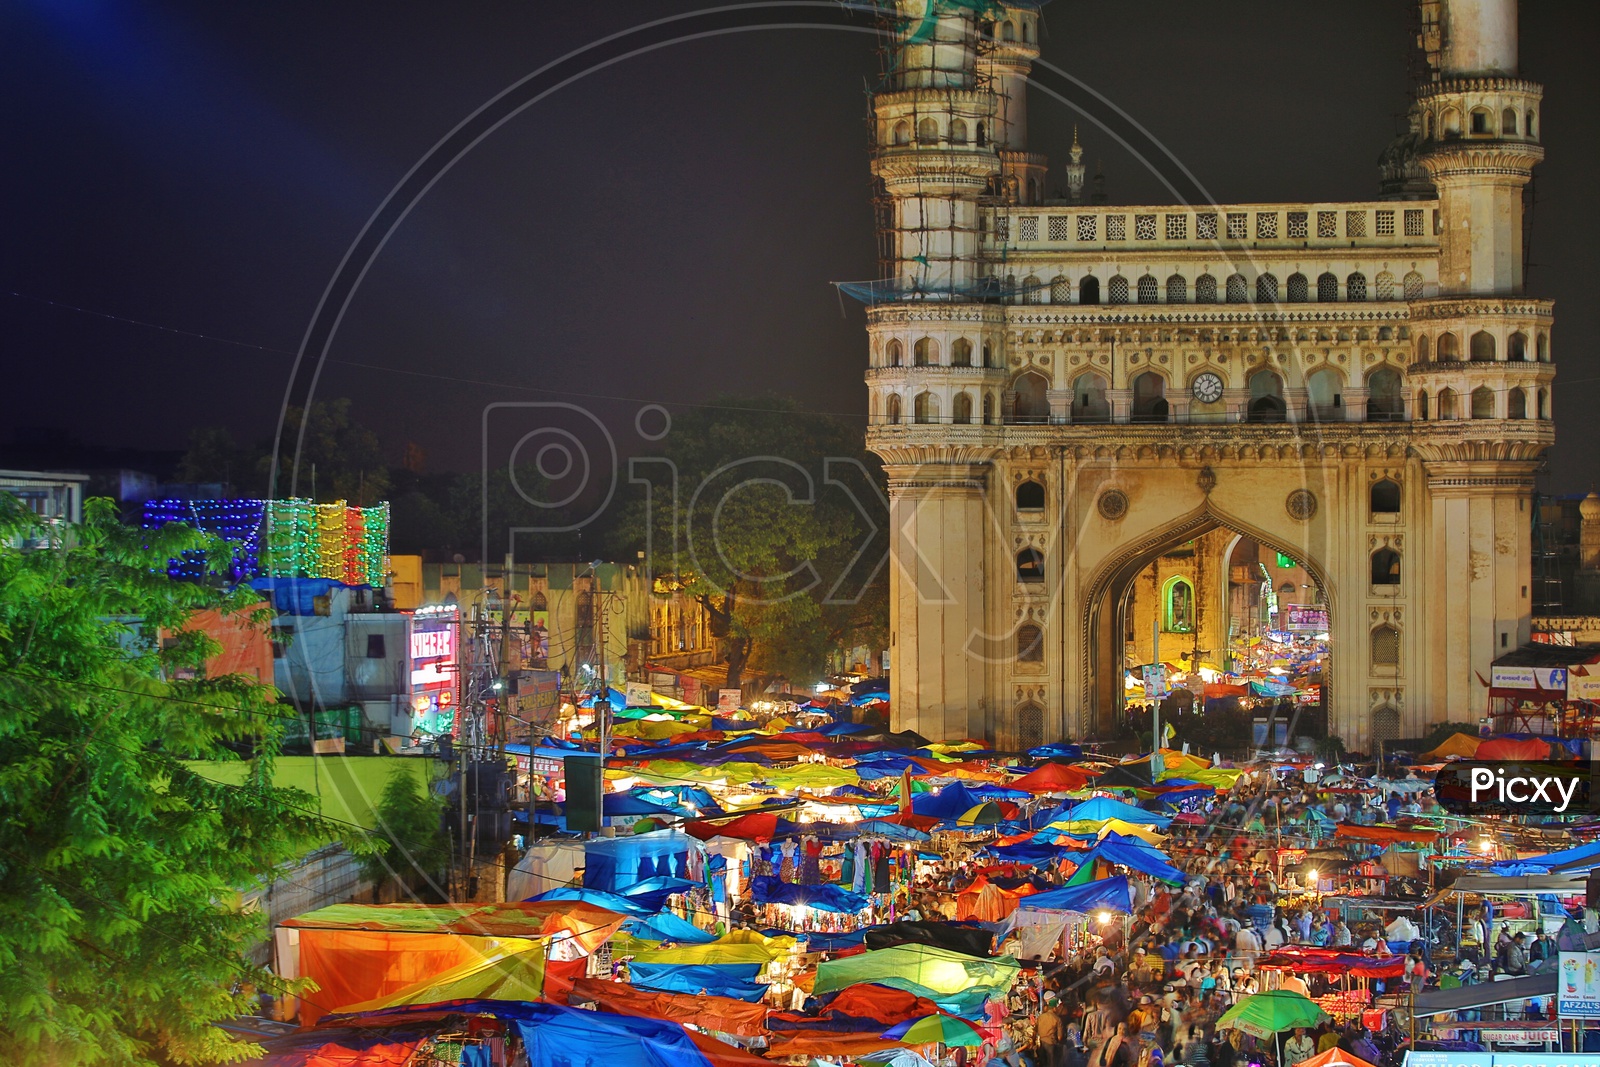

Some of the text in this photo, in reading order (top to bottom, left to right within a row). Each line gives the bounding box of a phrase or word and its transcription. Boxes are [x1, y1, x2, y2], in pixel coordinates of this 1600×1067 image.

[1563, 1001, 1600, 1009] AFZAL'S
[1482, 1031, 1557, 1041] SUGAR CANE JUICE
